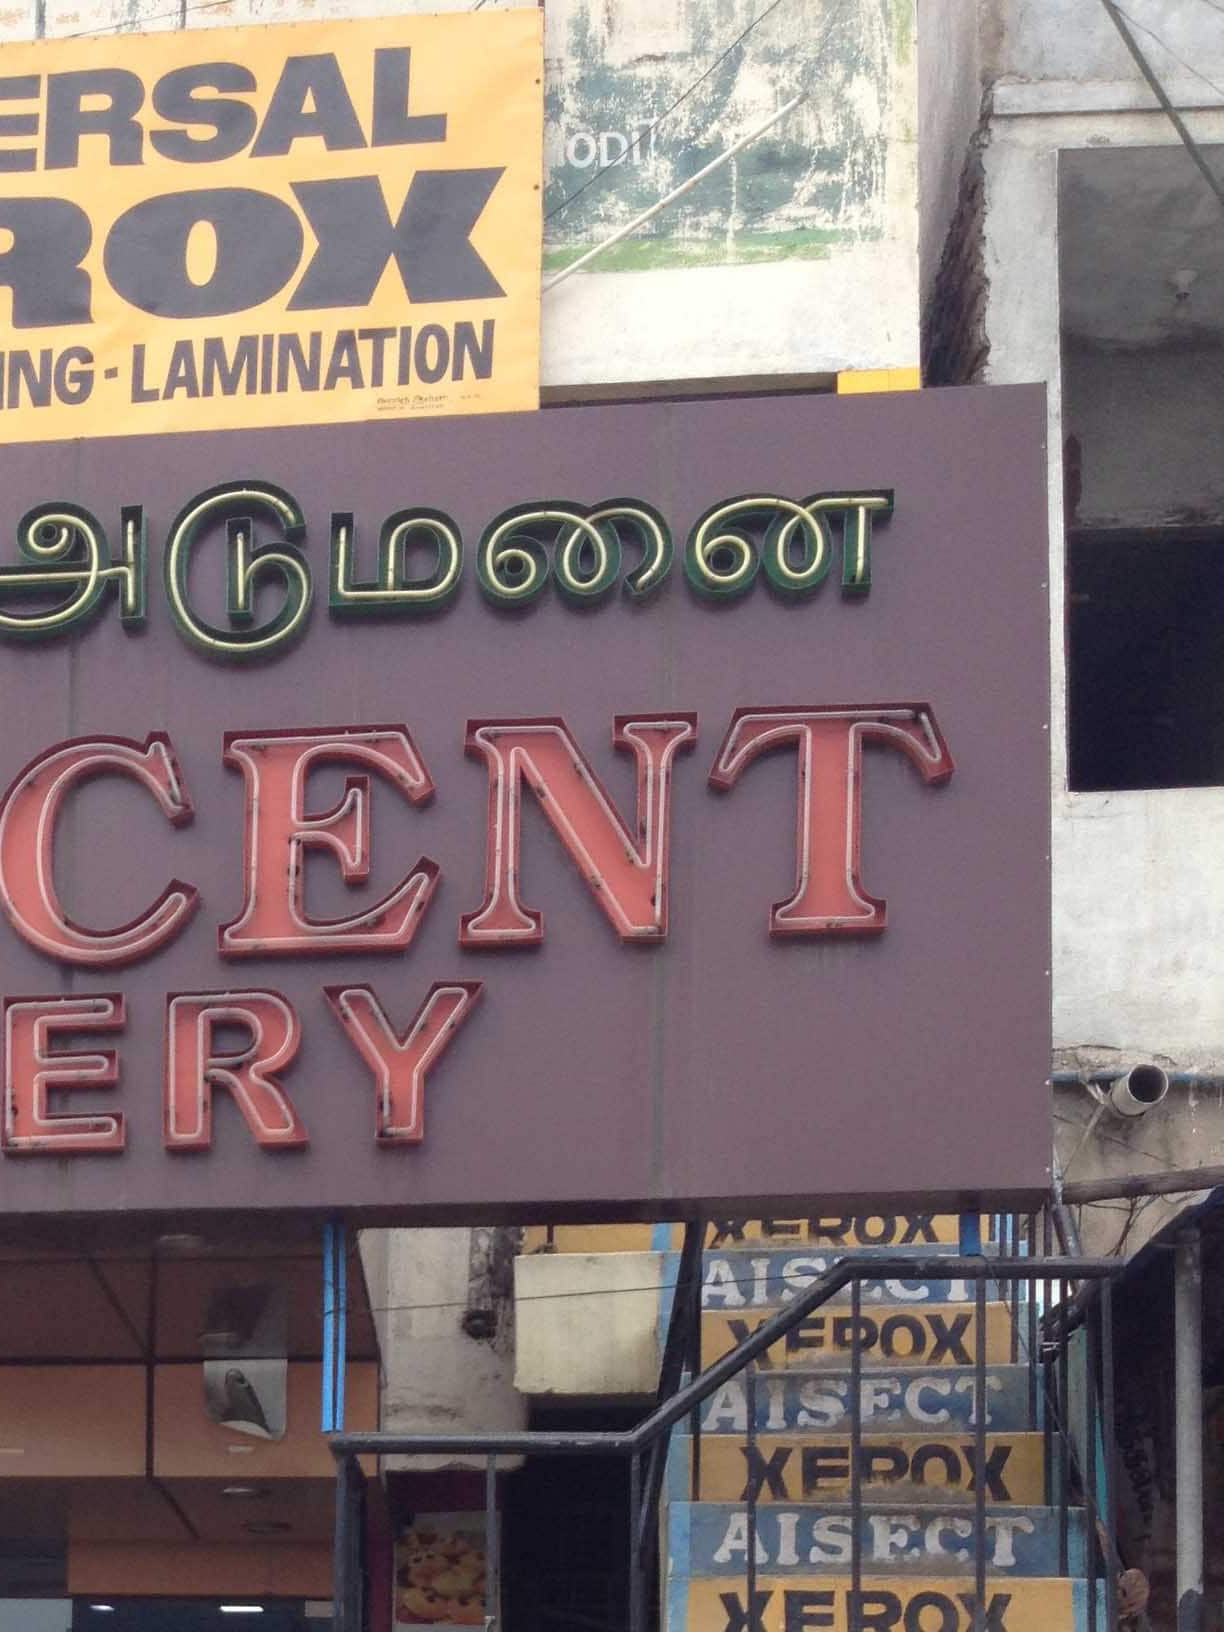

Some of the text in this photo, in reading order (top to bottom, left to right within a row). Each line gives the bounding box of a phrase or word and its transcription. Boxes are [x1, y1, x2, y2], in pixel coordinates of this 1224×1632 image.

[131, 319, 495, 404] LAMINATION
[702, 1374, 1003, 1431] AISECT
[713, 1511, 1035, 1567] AISECT
